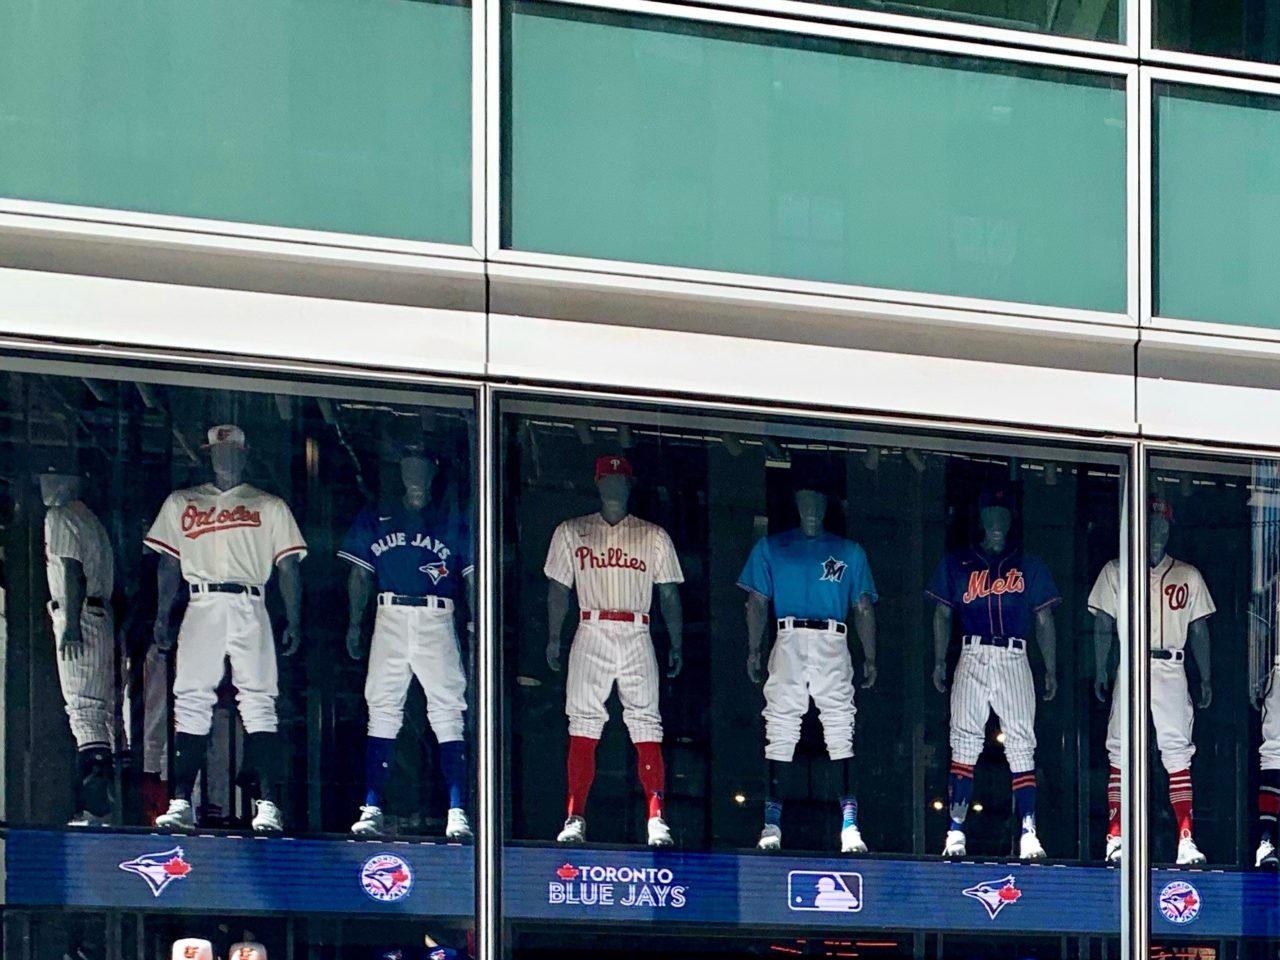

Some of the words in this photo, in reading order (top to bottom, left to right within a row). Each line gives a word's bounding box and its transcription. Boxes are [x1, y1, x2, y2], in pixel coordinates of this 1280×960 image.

[182, 505, 261, 535] Orioles
[371, 532, 406, 557] BLUE
[411, 533, 451, 560] JAYS
[575, 546, 646, 572] Phillies
[963, 568, 1025, 604] Mets
[1165, 583, 1189, 611] W
[578, 866, 673, 884] TORONTO
[548, 881, 614, 905] BLUE
[620, 884, 687, 908] JAYS
